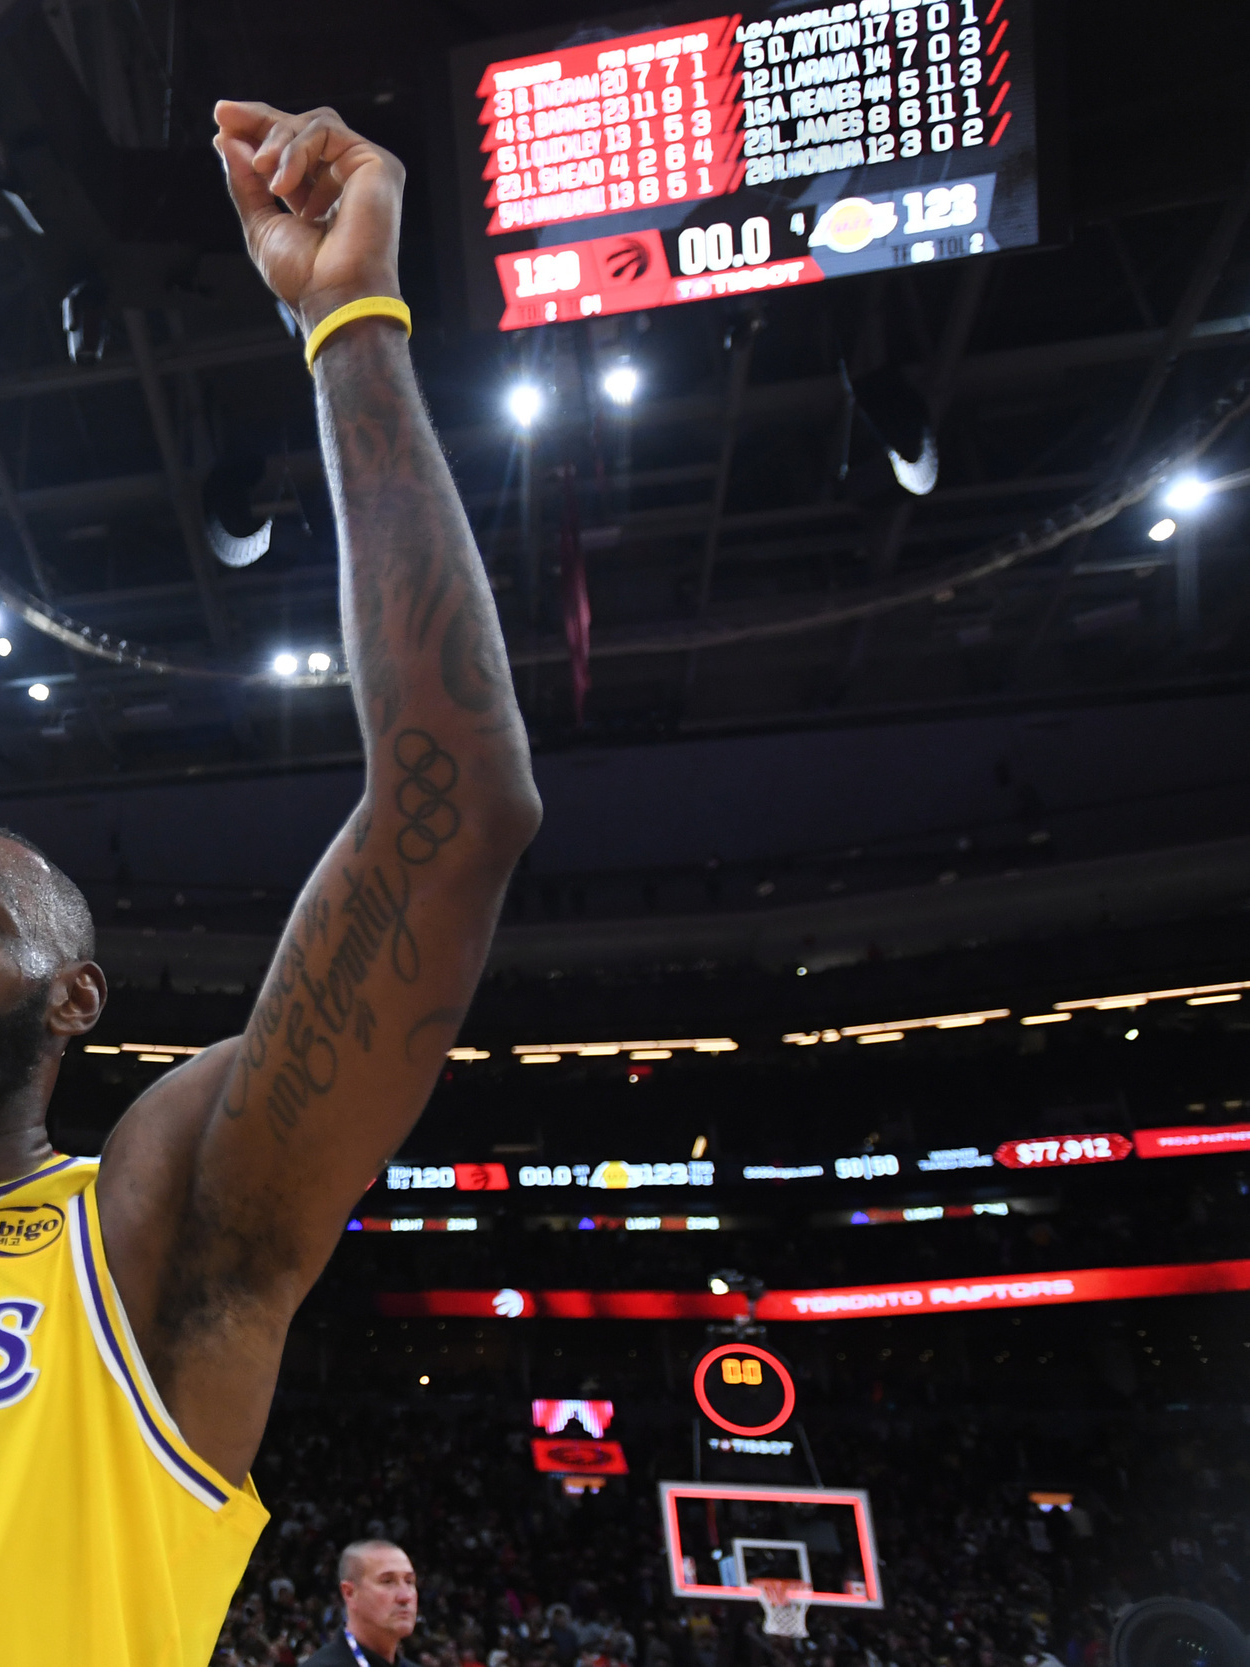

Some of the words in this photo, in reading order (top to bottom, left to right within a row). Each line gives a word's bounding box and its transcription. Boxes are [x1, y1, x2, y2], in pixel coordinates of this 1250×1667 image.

[742, 67, 770, 99] 12
[862, 44, 892, 76] 14
[896, 38, 918, 68] 7
[927, 32, 951, 63] 0
[958, 26, 981, 57] 3
[743, 39, 765, 69] 5
[791, 19, 861, 60] AYTON
[862, 13, 890, 46] 17
[895, 8, 919, 39] 8
[926, 2, 950, 33] 0
[960, 0, 979, 25] 1
[493, 90, 513, 117] 3
[532, 73, 599, 110] INGRAM
[600, 67, 628, 97] 20
[632, 62, 651, 90] 7
[660, 56, 679, 84] 7
[690, 52, 707, 79] 1
[495, 118, 515, 143] 4
[534, 101, 601, 138] BARNES
[602, 96, 629, 125] 23
[631, 90, 658, 120] 11
[661, 86, 683, 113] 9
[691, 81, 708, 108] 1
[743, 96, 772, 129] 15
[790, 80, 862, 120] REAVES
[863, 74, 892, 105] 44
[898, 69, 920, 99] 5
[926, 62, 955, 94] 11
[959, 57, 982, 87] 3
[496, 146, 517, 173] 5
[604, 124, 631, 153] 13
[637, 120, 655, 147] 1
[663, 114, 684, 142] 5
[690, 109, 712, 137] 3
[743, 125, 772, 158] 23
[793, 109, 864, 149] JAMES
[867, 104, 891, 134] 8
[898, 98, 921, 129] 6
[926, 92, 956, 124] 11
[962, 87, 981, 117] 1
[745, 154, 774, 187] 28
[865, 133, 895, 165] 12
[900, 128, 922, 159] 3
[930, 122, 954, 154] 0
[961, 117, 984, 148] 2
[496, 173, 521, 201] 23
[537, 158, 604, 194] SHEAD
[609, 153, 630, 179] 4
[637, 148, 657, 176] 2
[664, 143, 686, 171] 6
[692, 138, 714, 164] 4
[608, 180, 635, 210] 13
[638, 176, 660, 204] 8
[666, 171, 687, 199] 5
[696, 167, 713, 194] 1
[902, 183, 977, 235] 123
[678, 216, 771, 276] 00.0
[969, 232, 984, 254] 2
[411, 1166, 456, 1189] 120
[518, 1165, 573, 1187] 00.0
[792, 1290, 923, 1314] TORONTO
[930, 1280, 1074, 1305] RAPTORS
